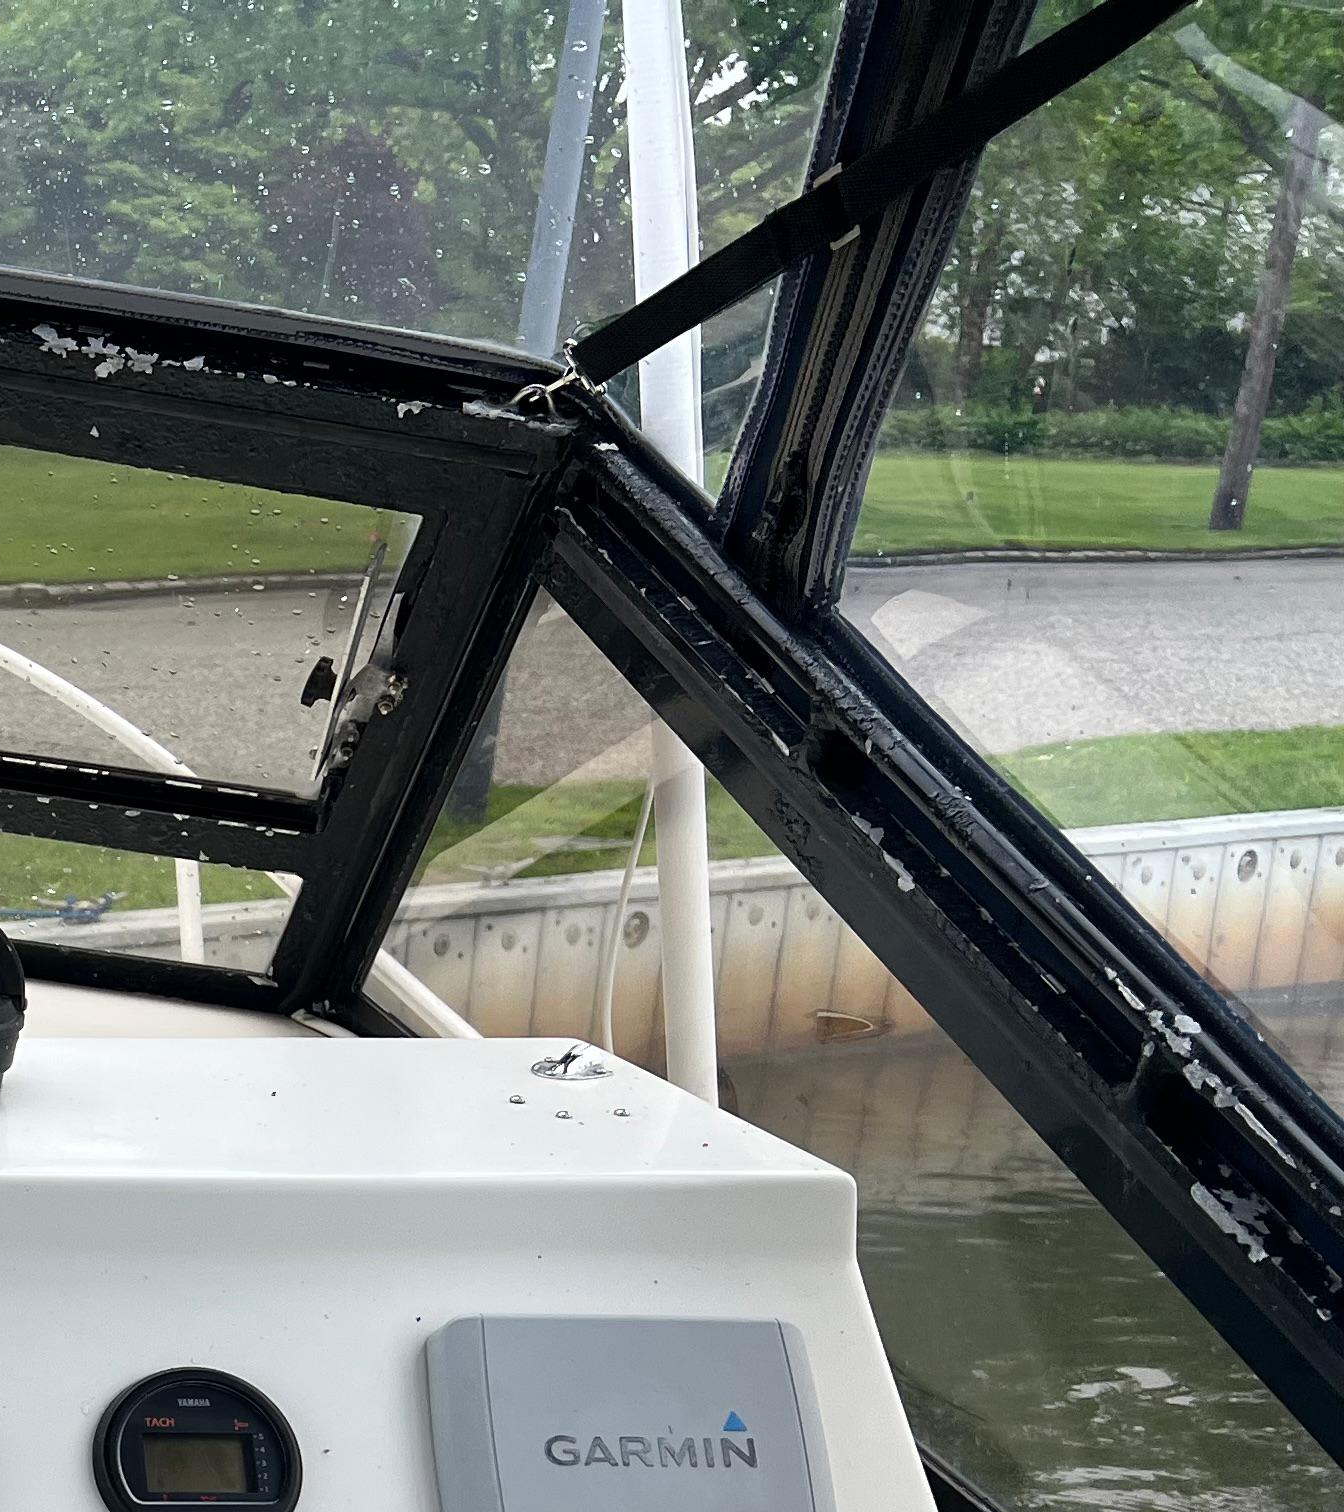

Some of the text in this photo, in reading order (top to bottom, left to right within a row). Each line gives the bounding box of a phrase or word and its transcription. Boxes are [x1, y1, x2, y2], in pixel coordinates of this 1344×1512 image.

[177, 1398, 211, 1407] YAMAHA
[144, 1417, 176, 1427] TACH
[544, 1434, 758, 1469] GARMIN
